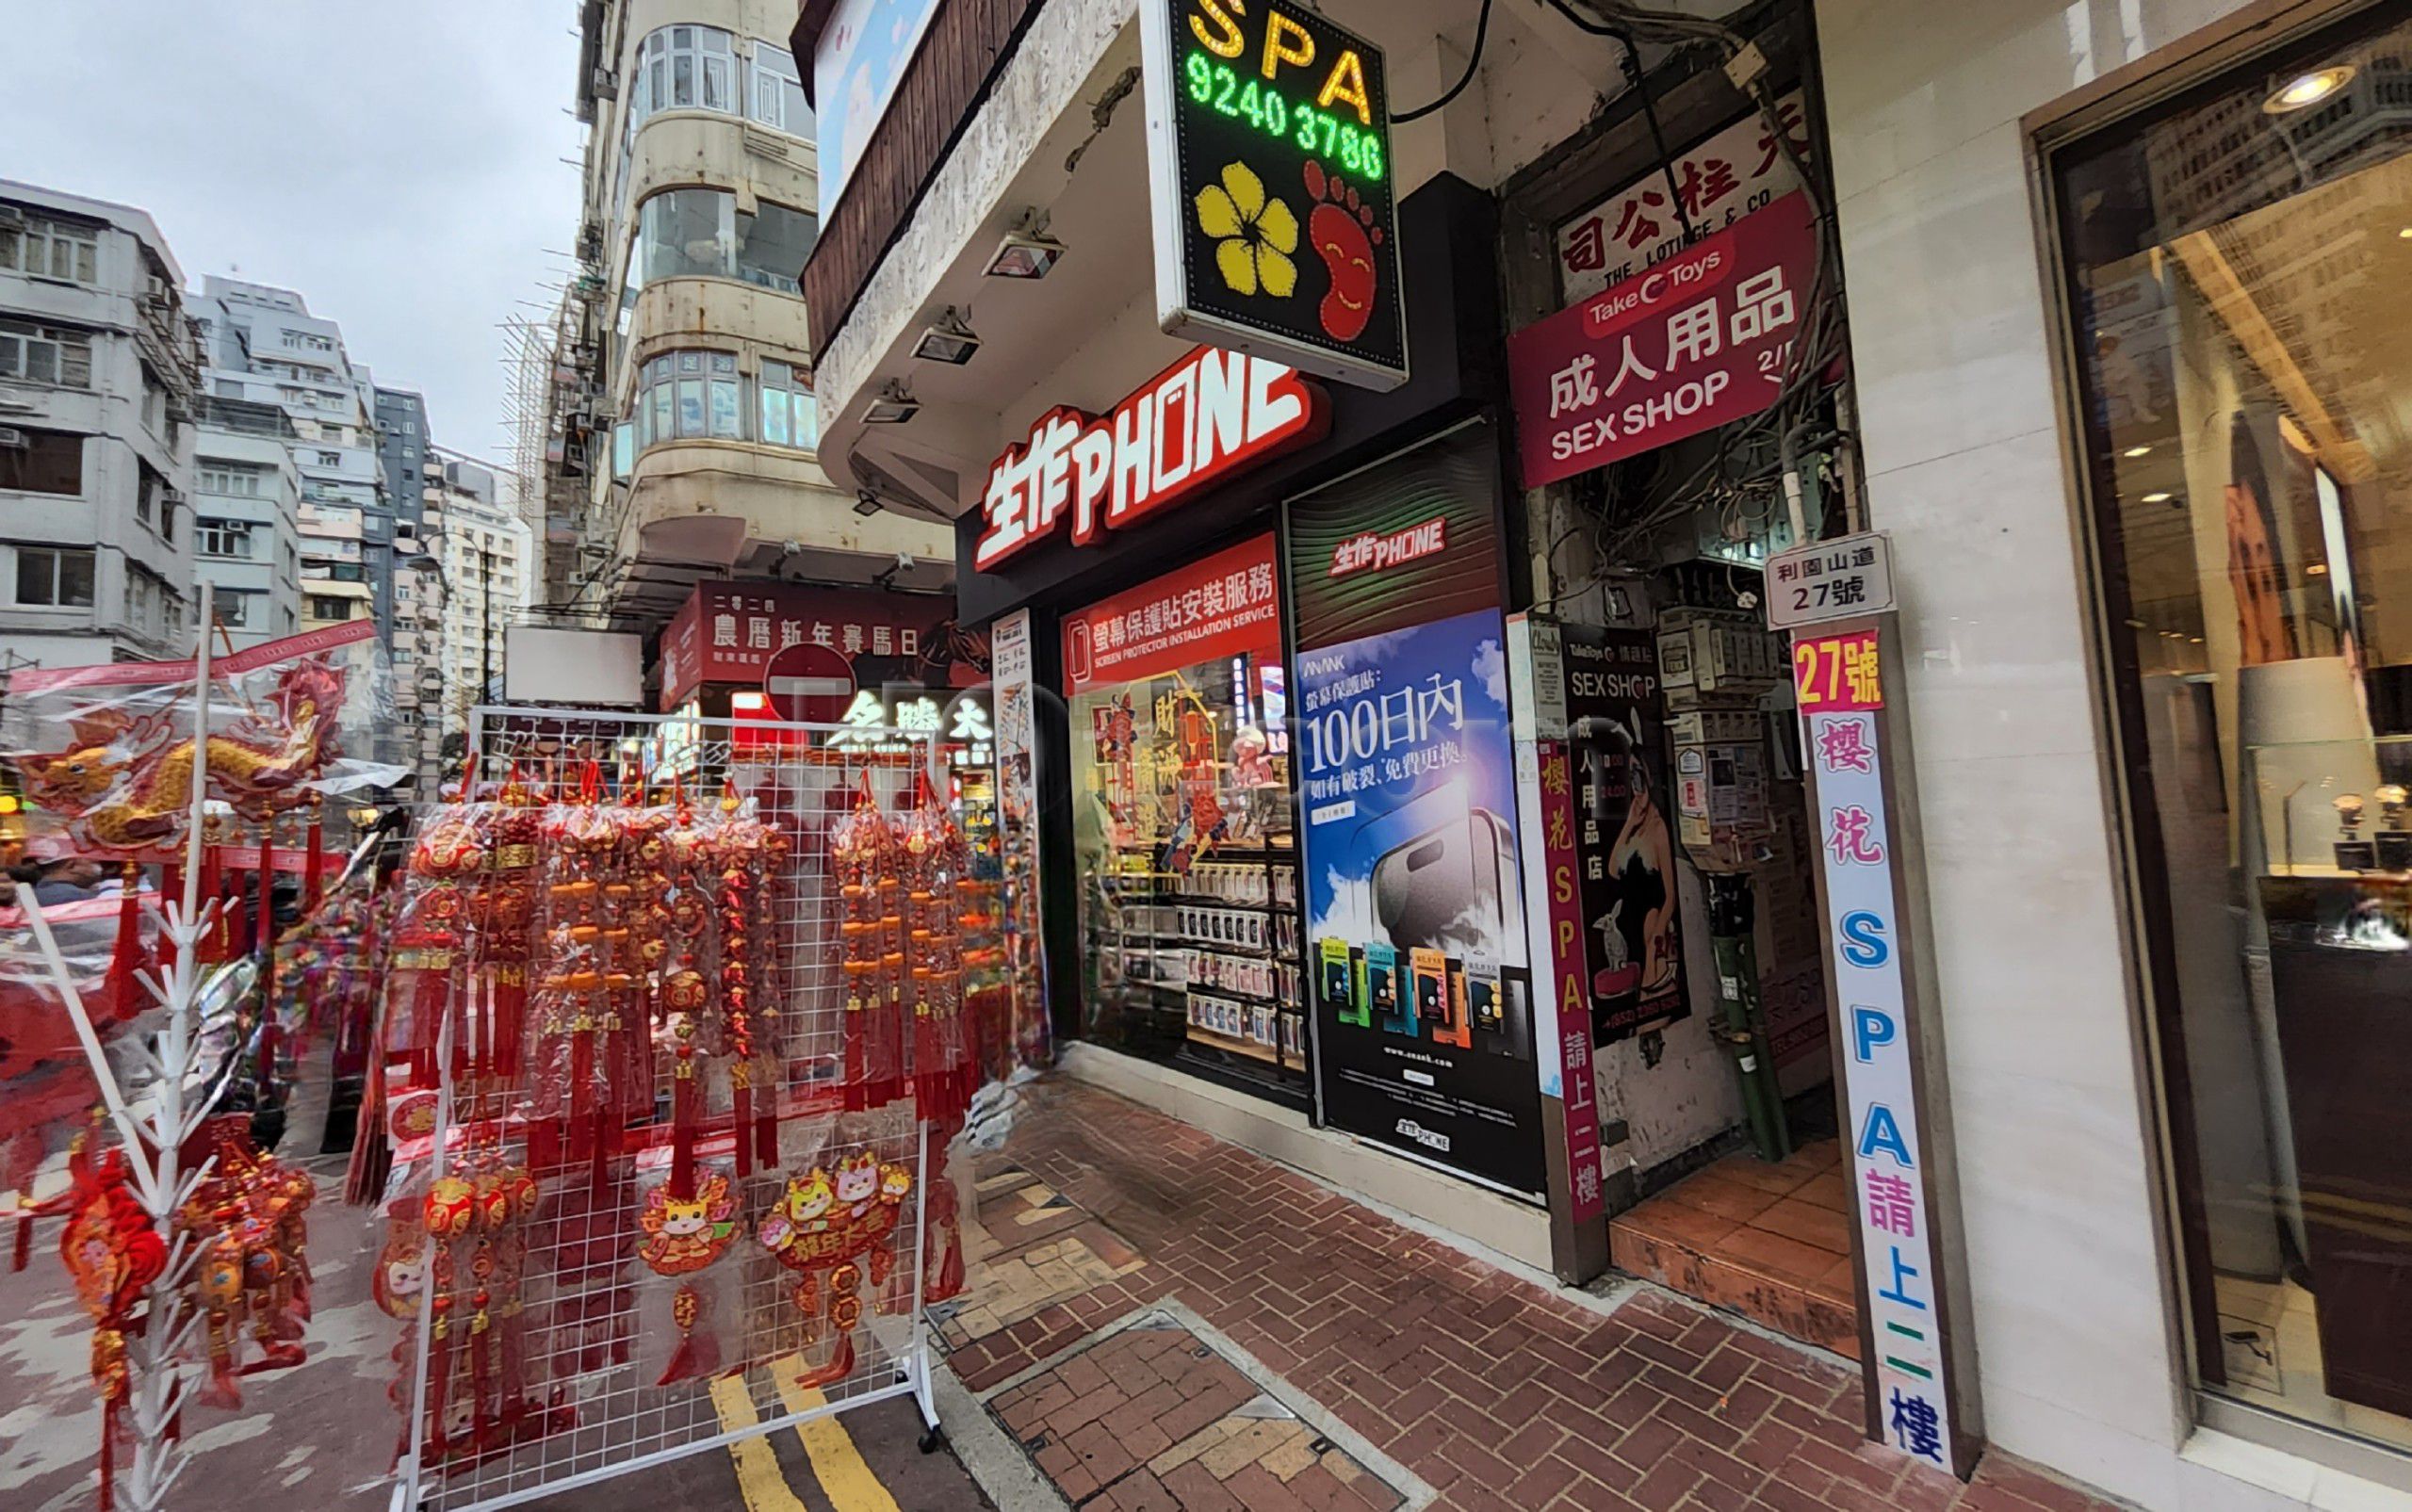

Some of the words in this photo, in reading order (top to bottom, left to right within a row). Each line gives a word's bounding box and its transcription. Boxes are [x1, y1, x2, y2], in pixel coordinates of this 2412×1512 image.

[1187, 53, 1286, 137] 9240
[1189, 0, 1371, 125] SPA
[1589, 292, 1638, 325] Take
[1667, 249, 1721, 287] Toys
[1605, 261, 1633, 288] THE
[1550, 265, 1795, 419] 成人用品
[1551, 412, 1618, 461] SEX
[1622, 368, 1730, 436] SHOP
[1093, 562, 1273, 653] 螢幕保護貼安裝服務
[1777, 545, 1876, 583] 利園山道
[1793, 576, 1866, 610] 27號
[1095, 653, 1121, 669] SCREEN
[1123, 638, 1167, 659] PROTECTOR
[1169, 618, 1231, 646] INSTALLATION
[1233, 604, 1275, 628] SERVICE
[1796, 639, 1882, 705] 27號
[1307, 673, 1463, 772] 100日內
[1572, 672, 1607, 698] SEX
[1541, 756, 1573, 852] 櫻花
[1576, 715, 1603, 881] 成人用品店
[1818, 720, 1882, 864] 櫻花
[1555, 866, 1583, 1012] SPA
[1841, 909, 1915, 1169] SPA
[1564, 1032, 1600, 1206] 請上二樓
[1864, 1168, 1944, 1465] 請上二樓
